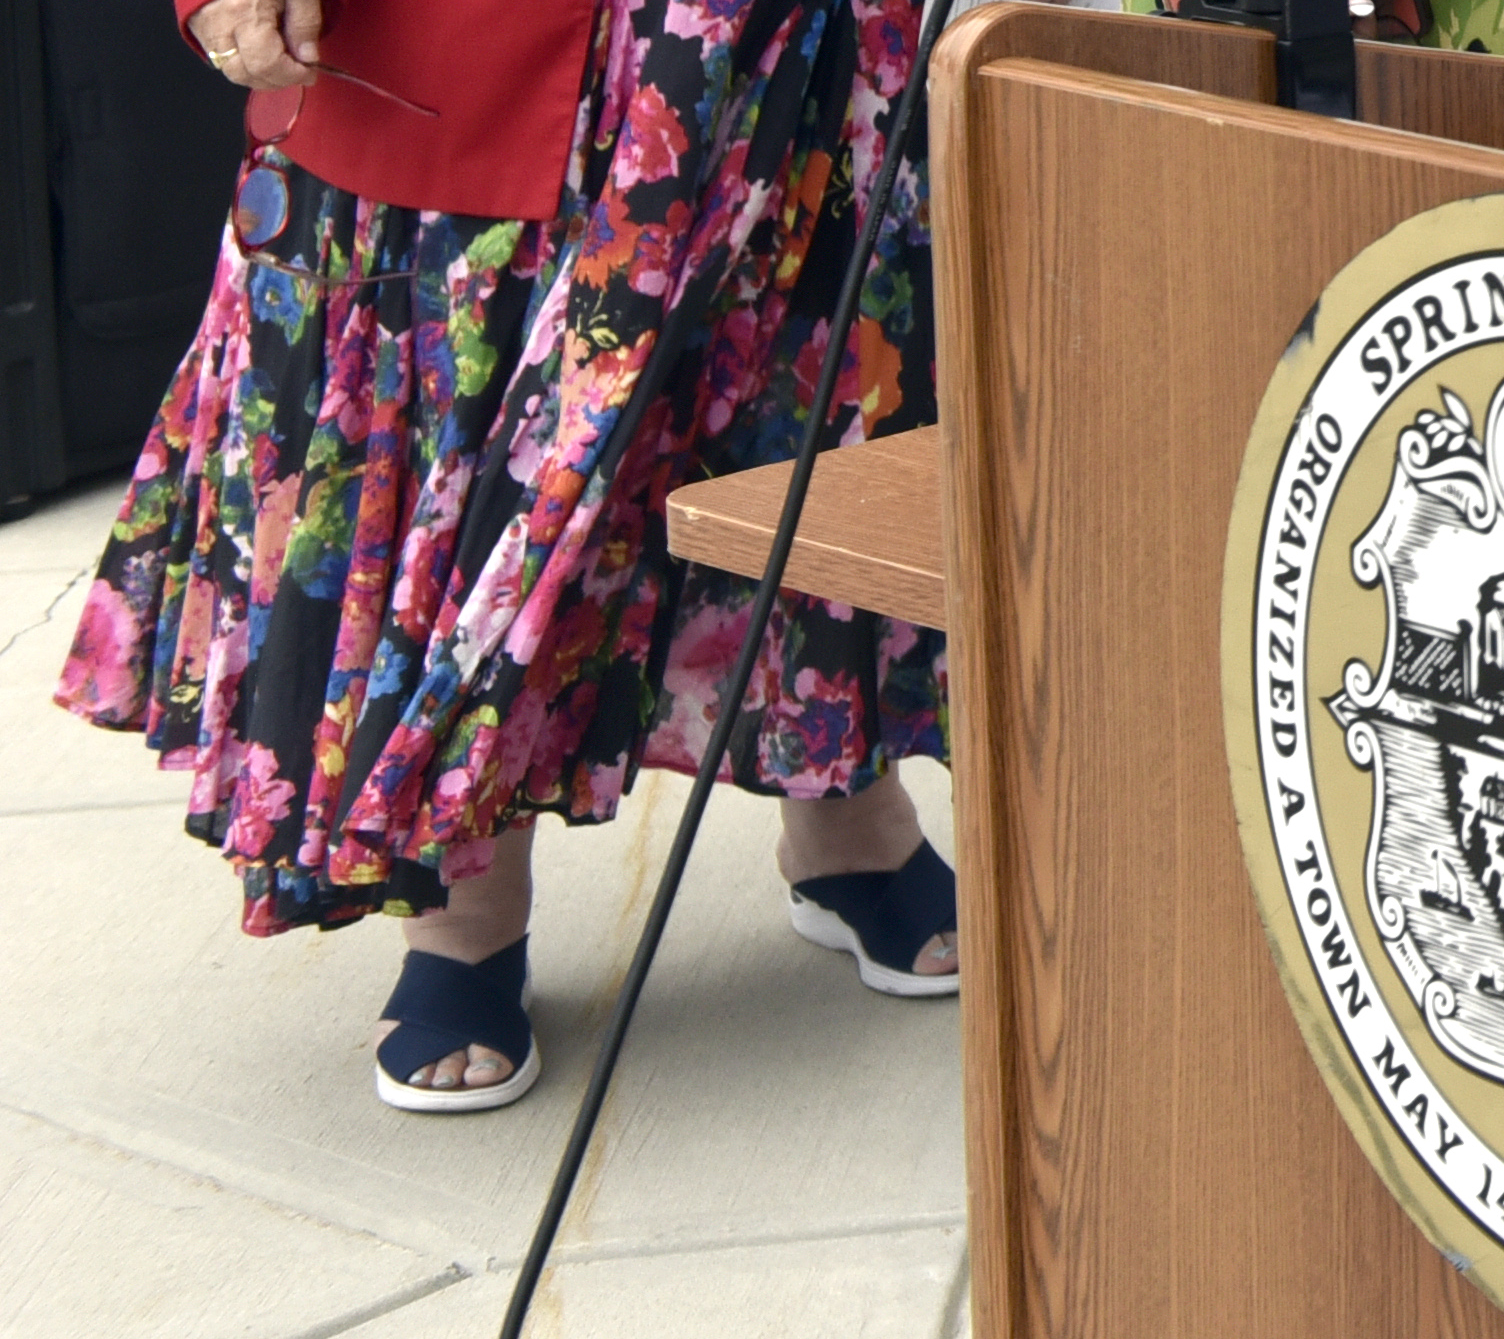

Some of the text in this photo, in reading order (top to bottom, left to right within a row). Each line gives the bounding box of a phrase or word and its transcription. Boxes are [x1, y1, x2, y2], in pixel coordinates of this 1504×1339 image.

[1269, 413, 1342, 758] ORGANIZED
[1277, 777, 1306, 826] A
[1294, 840, 1371, 1019] TOWN
[1372, 1036, 1464, 1164] MAY
